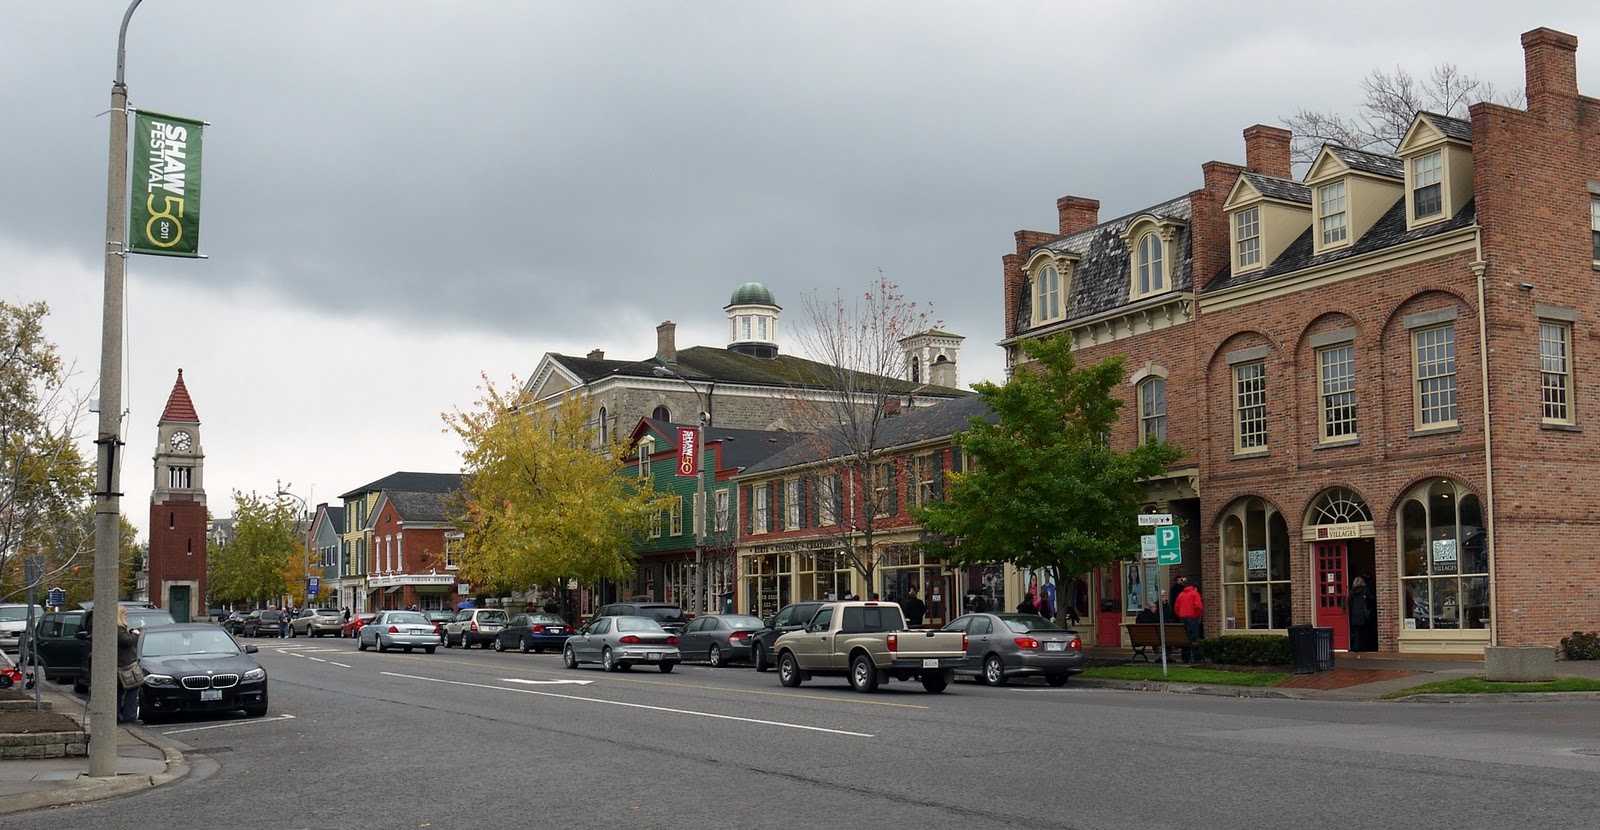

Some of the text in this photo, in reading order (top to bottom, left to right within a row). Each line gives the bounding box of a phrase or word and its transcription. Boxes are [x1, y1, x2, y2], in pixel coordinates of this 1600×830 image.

[148, 121, 165, 193] FESTIVAL
[163, 124, 187, 195] SHAW
[146, 193, 185, 248] 50
[160, 221, 169, 239] 2011
[686, 431, 694, 456] SHAW
[681, 456, 693, 474] 50
[1162, 529, 1175, 546] P
[1329, 530, 1356, 538] VILLAGES
